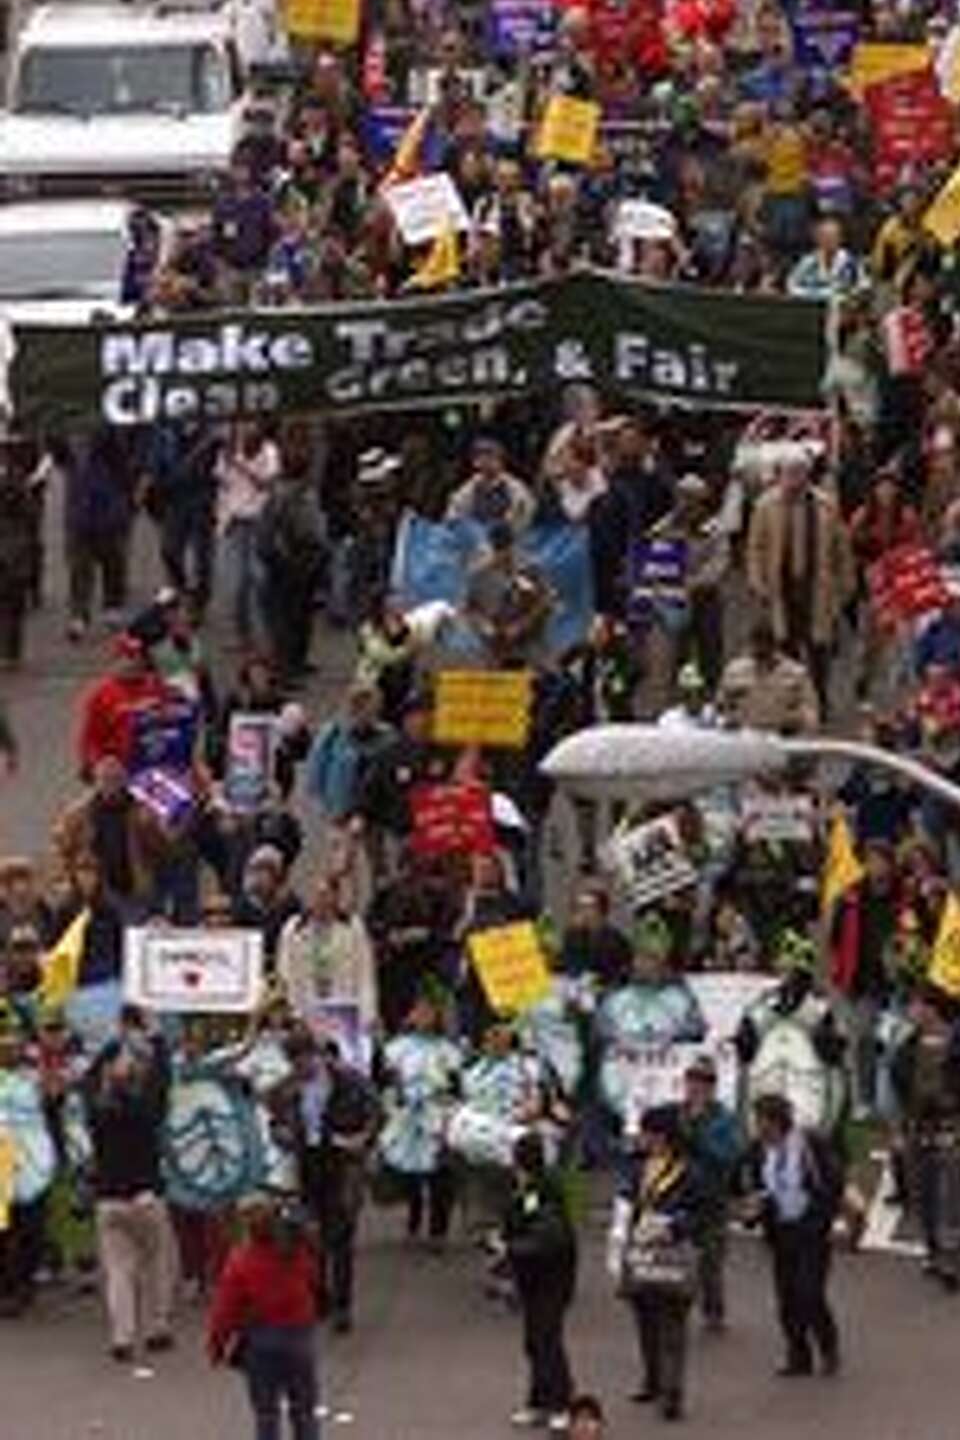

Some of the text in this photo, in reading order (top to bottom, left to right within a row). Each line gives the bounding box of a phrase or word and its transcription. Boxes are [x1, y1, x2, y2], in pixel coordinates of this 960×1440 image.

[102, 324, 314, 374] Make
[103, 377, 279, 425] Clean
[554, 339, 594, 380] &
[612, 332, 739, 393] Fair
